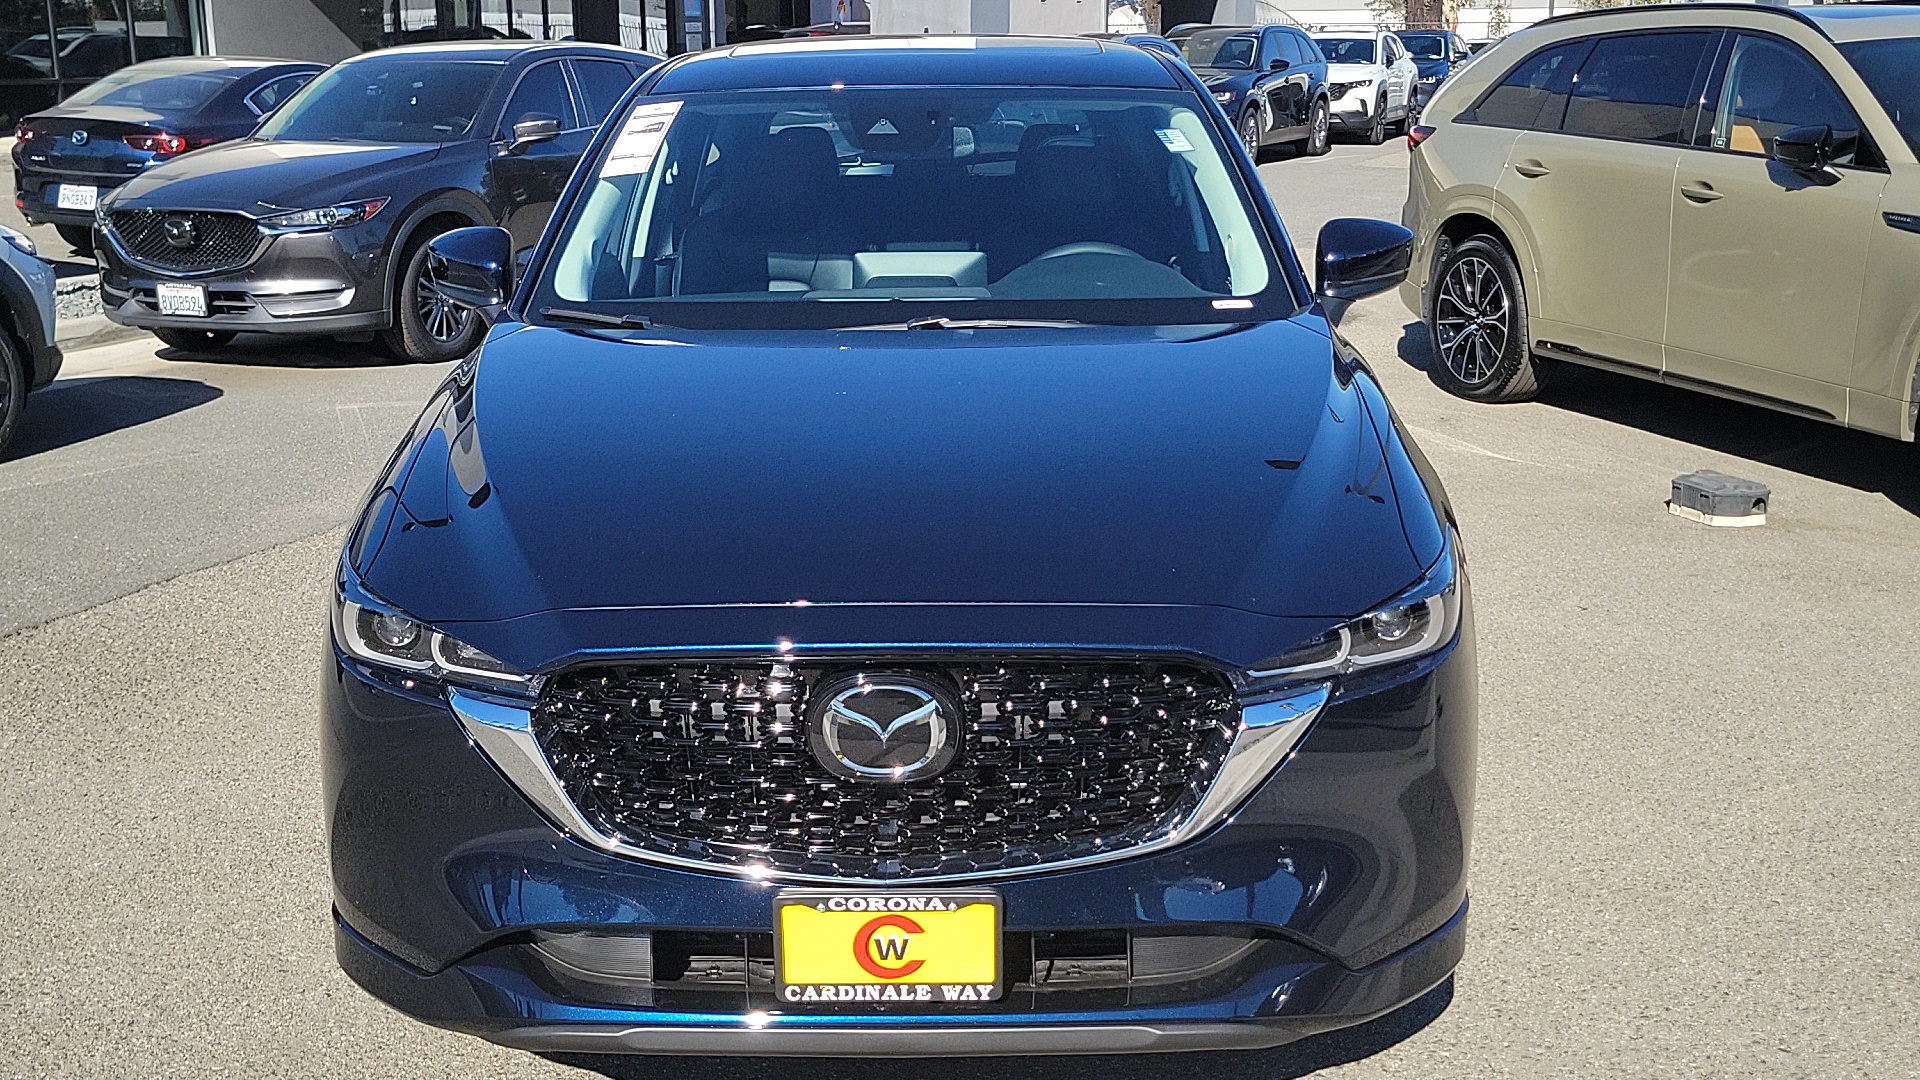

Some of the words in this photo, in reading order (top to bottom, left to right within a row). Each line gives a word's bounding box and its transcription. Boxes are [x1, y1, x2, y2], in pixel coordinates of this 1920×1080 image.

[827, 897, 949, 912] CORONA
[784, 985, 932, 1001] CARDINALE
[941, 985, 994, 1001] WAY
